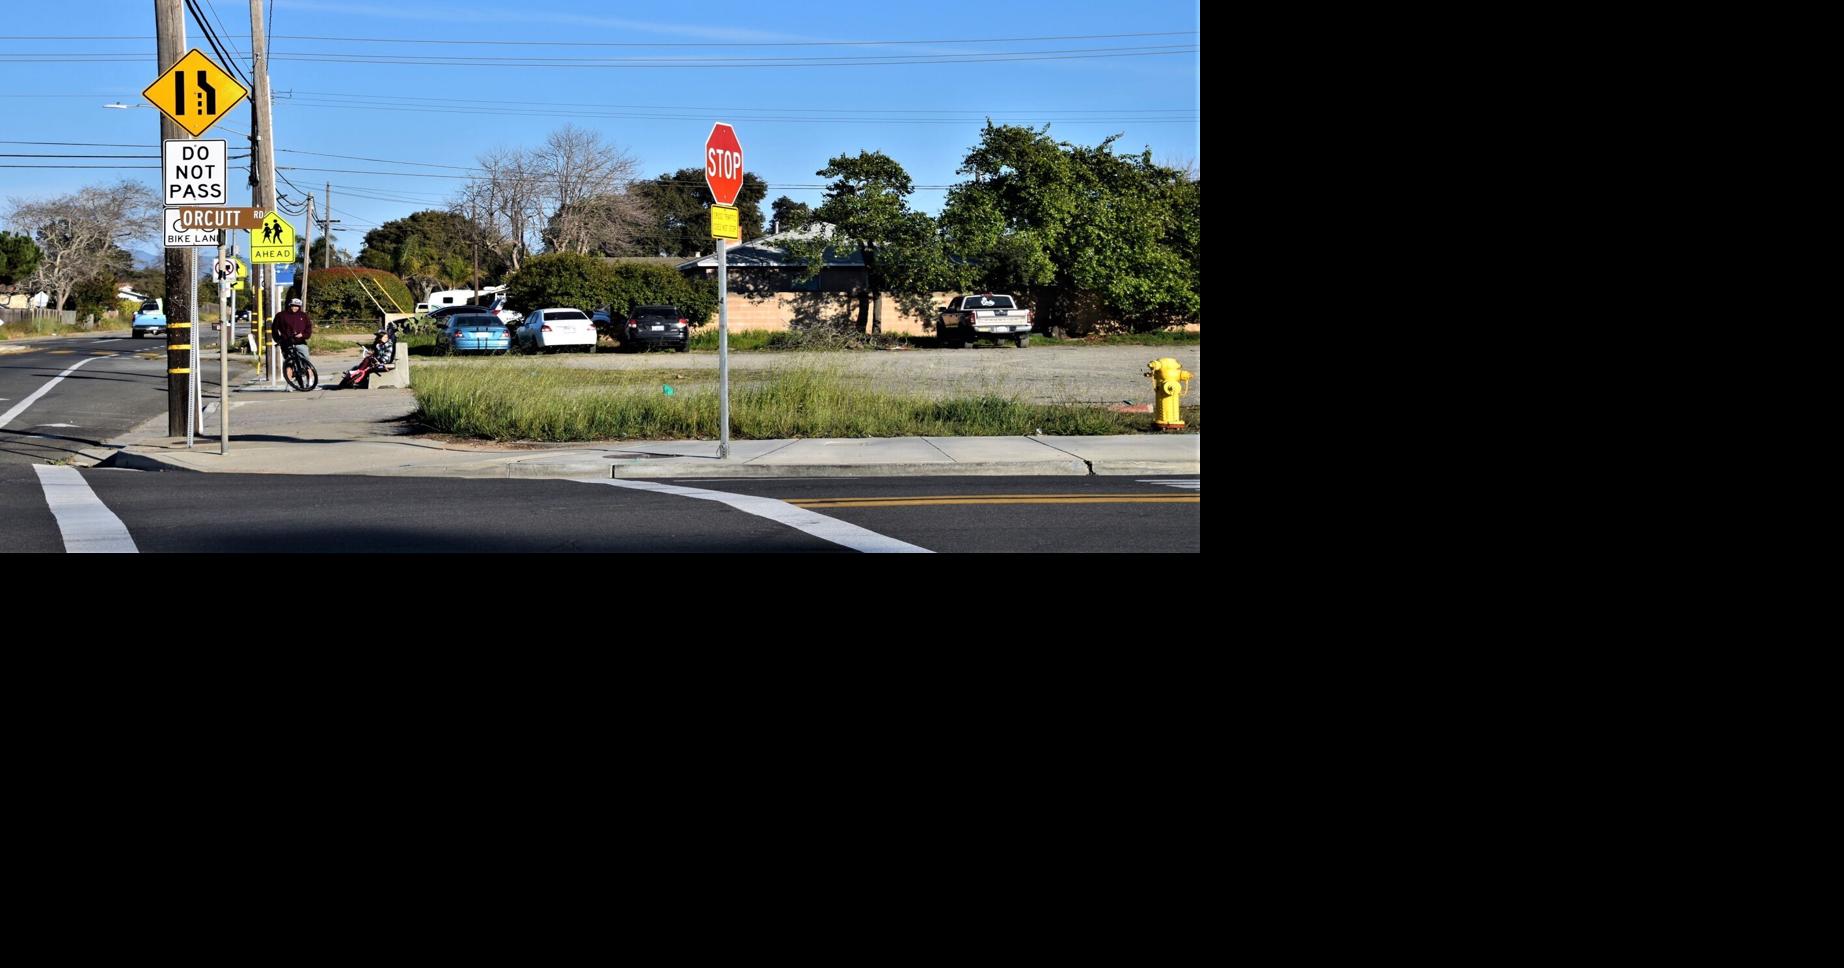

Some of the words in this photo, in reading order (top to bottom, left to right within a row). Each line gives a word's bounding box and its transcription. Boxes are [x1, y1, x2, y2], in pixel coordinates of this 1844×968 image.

[182, 146, 209, 160] DO
[708, 147, 741, 180] STOP
[176, 165, 216, 179] NOT
[170, 183, 222, 198] PASS
[183, 210, 240, 226] ORCUTT
[253, 211, 264, 219] RD
[168, 235, 191, 243] BIKE
[195, 235, 219, 243] LAN
[255, 250, 290, 258] AHEAD
